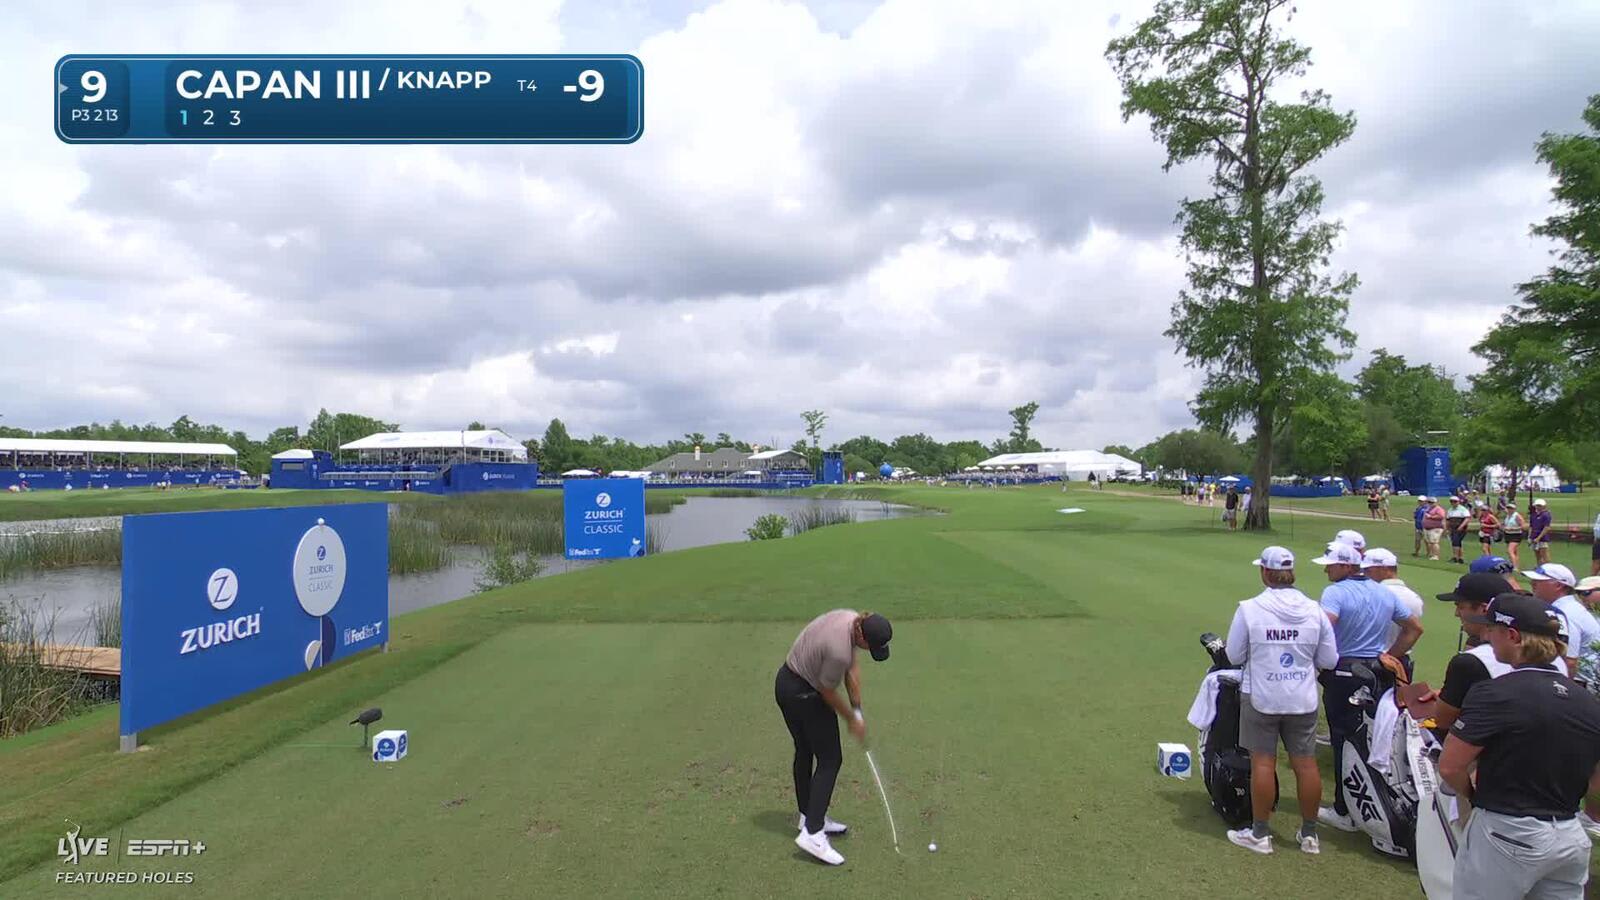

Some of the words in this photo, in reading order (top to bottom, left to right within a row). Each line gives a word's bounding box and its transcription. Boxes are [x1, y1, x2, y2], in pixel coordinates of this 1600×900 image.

[584, 509, 623, 520] ZURICH
[584, 524, 623, 534] CLASSIC
[308, 564, 334, 574] ZURICH
[180, 612, 261, 654] ZURICH
[1266, 629, 1299, 641] KNAPP
[1266, 671, 1307, 682] ZURICH
[1343, 763, 1383, 822] PXG
